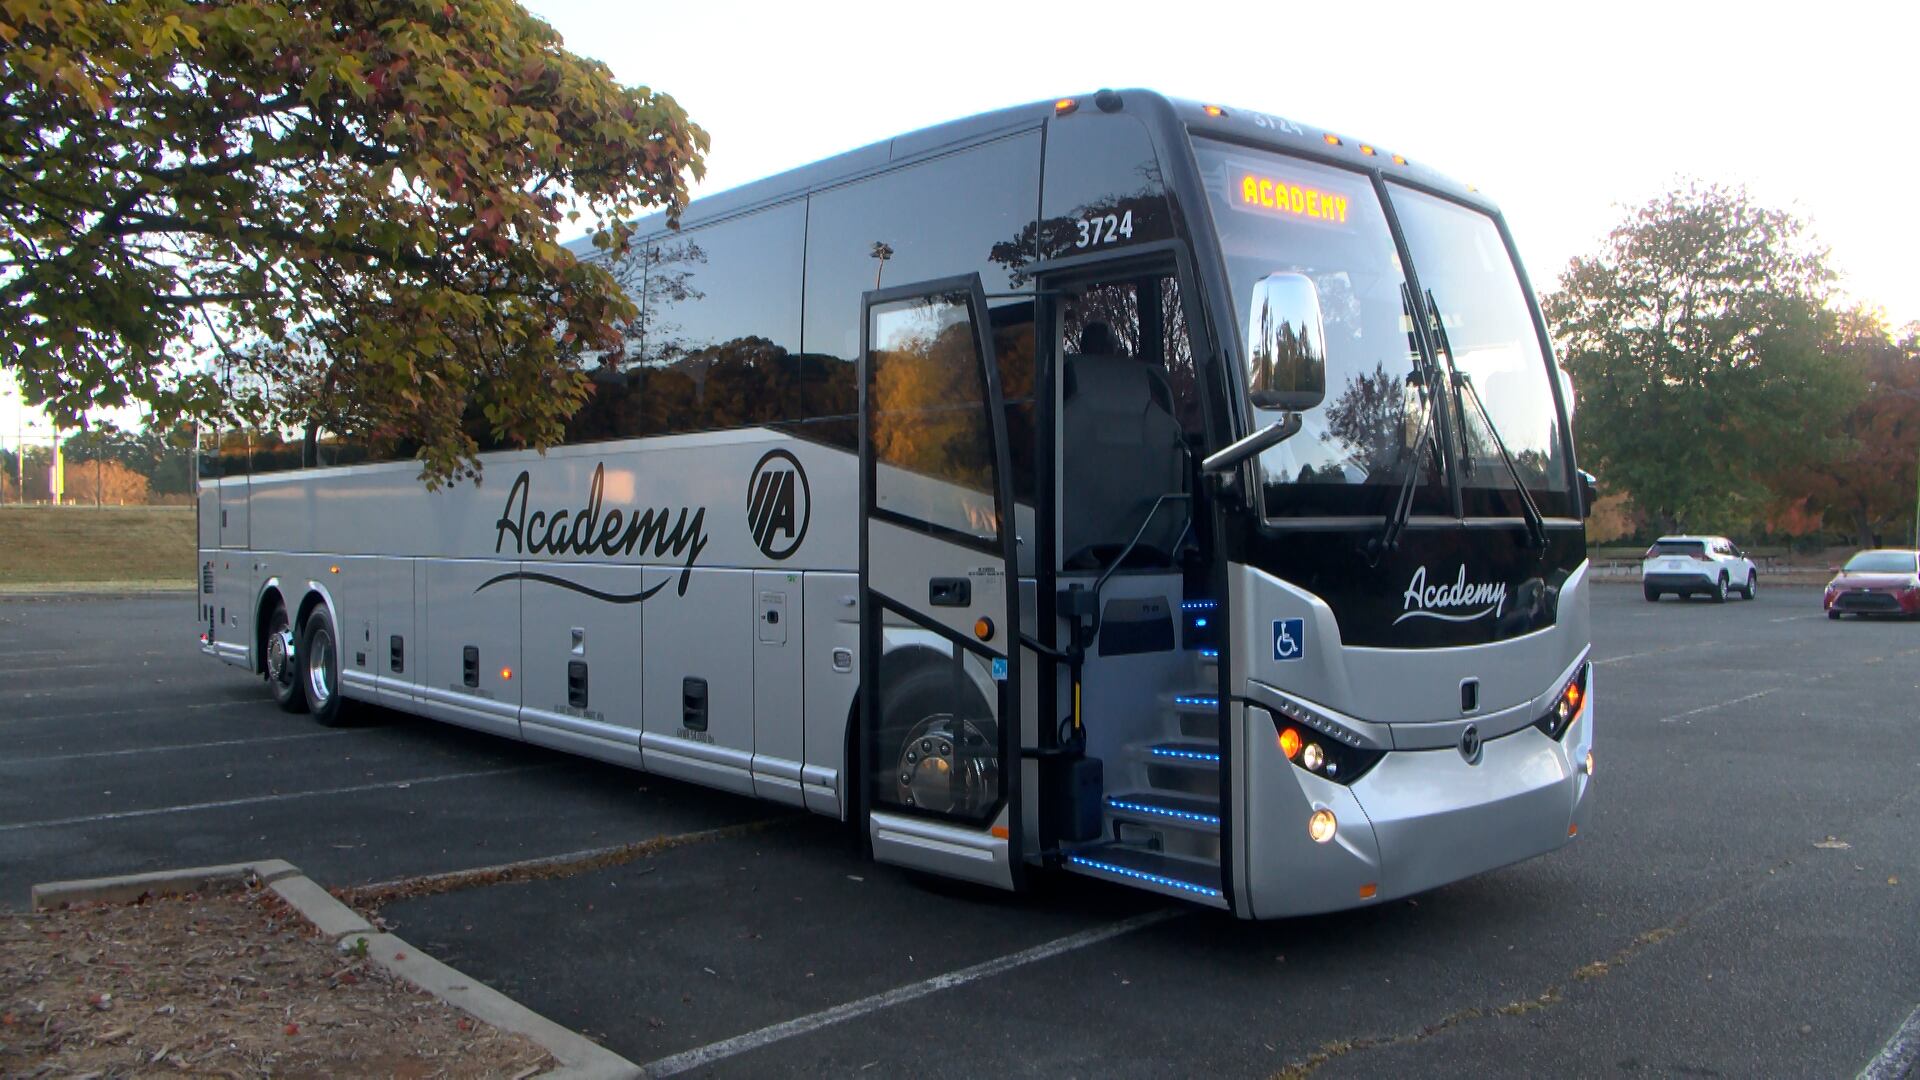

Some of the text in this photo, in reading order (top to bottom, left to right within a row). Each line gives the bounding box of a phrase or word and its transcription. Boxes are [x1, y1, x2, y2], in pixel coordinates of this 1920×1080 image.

[1242, 175, 1347, 222] ACADEMY
[1075, 209, 1133, 248] 3724
[495, 461, 708, 597] Academy
[1403, 563, 1507, 618] Academy
